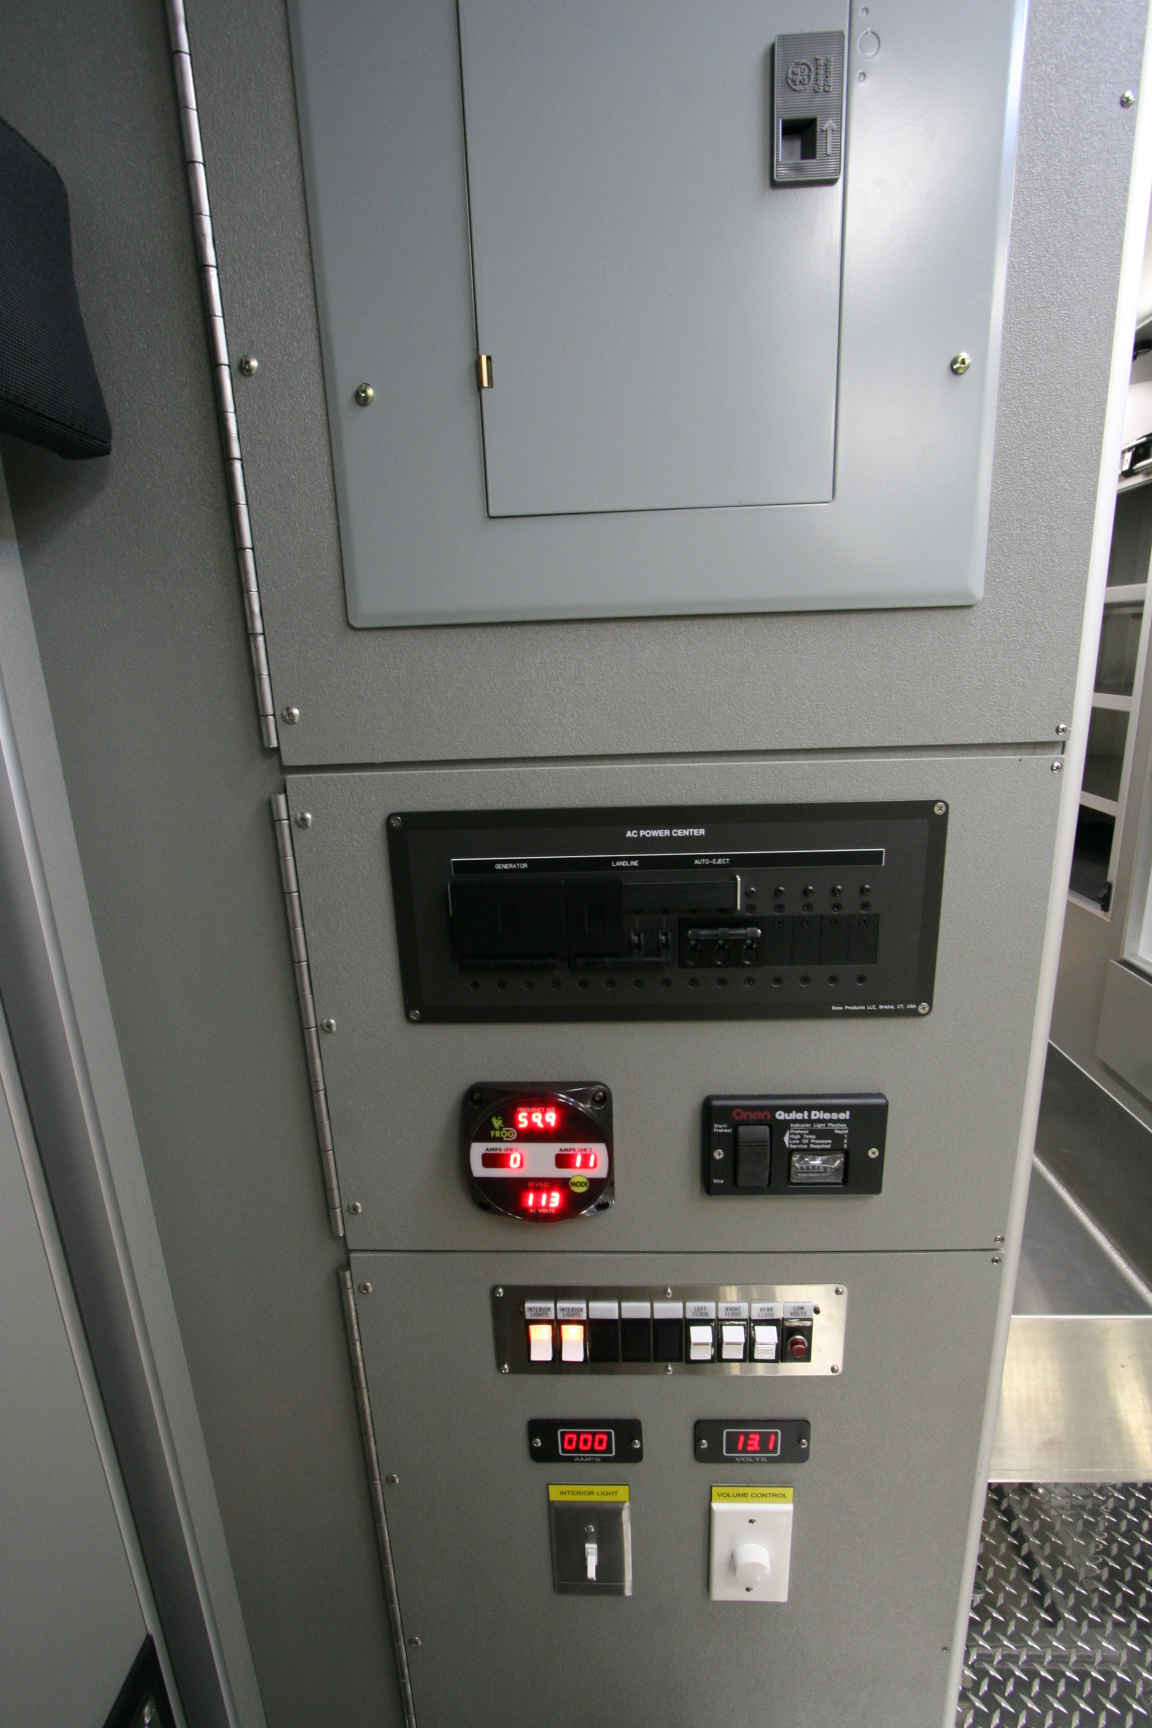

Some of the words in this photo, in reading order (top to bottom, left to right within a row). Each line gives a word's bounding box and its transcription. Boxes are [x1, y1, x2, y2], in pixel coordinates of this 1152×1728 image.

[824, 55, 832, 92] Electric
[626, 830, 638, 838] AC
[518, 1112, 556, 1128] 59.9
[775, 1111, 809, 1120] Quiet
[811, 1111, 850, 1120] Diesel
[510, 1154, 521, 1168] 0
[528, 1192, 559, 1207] 113
